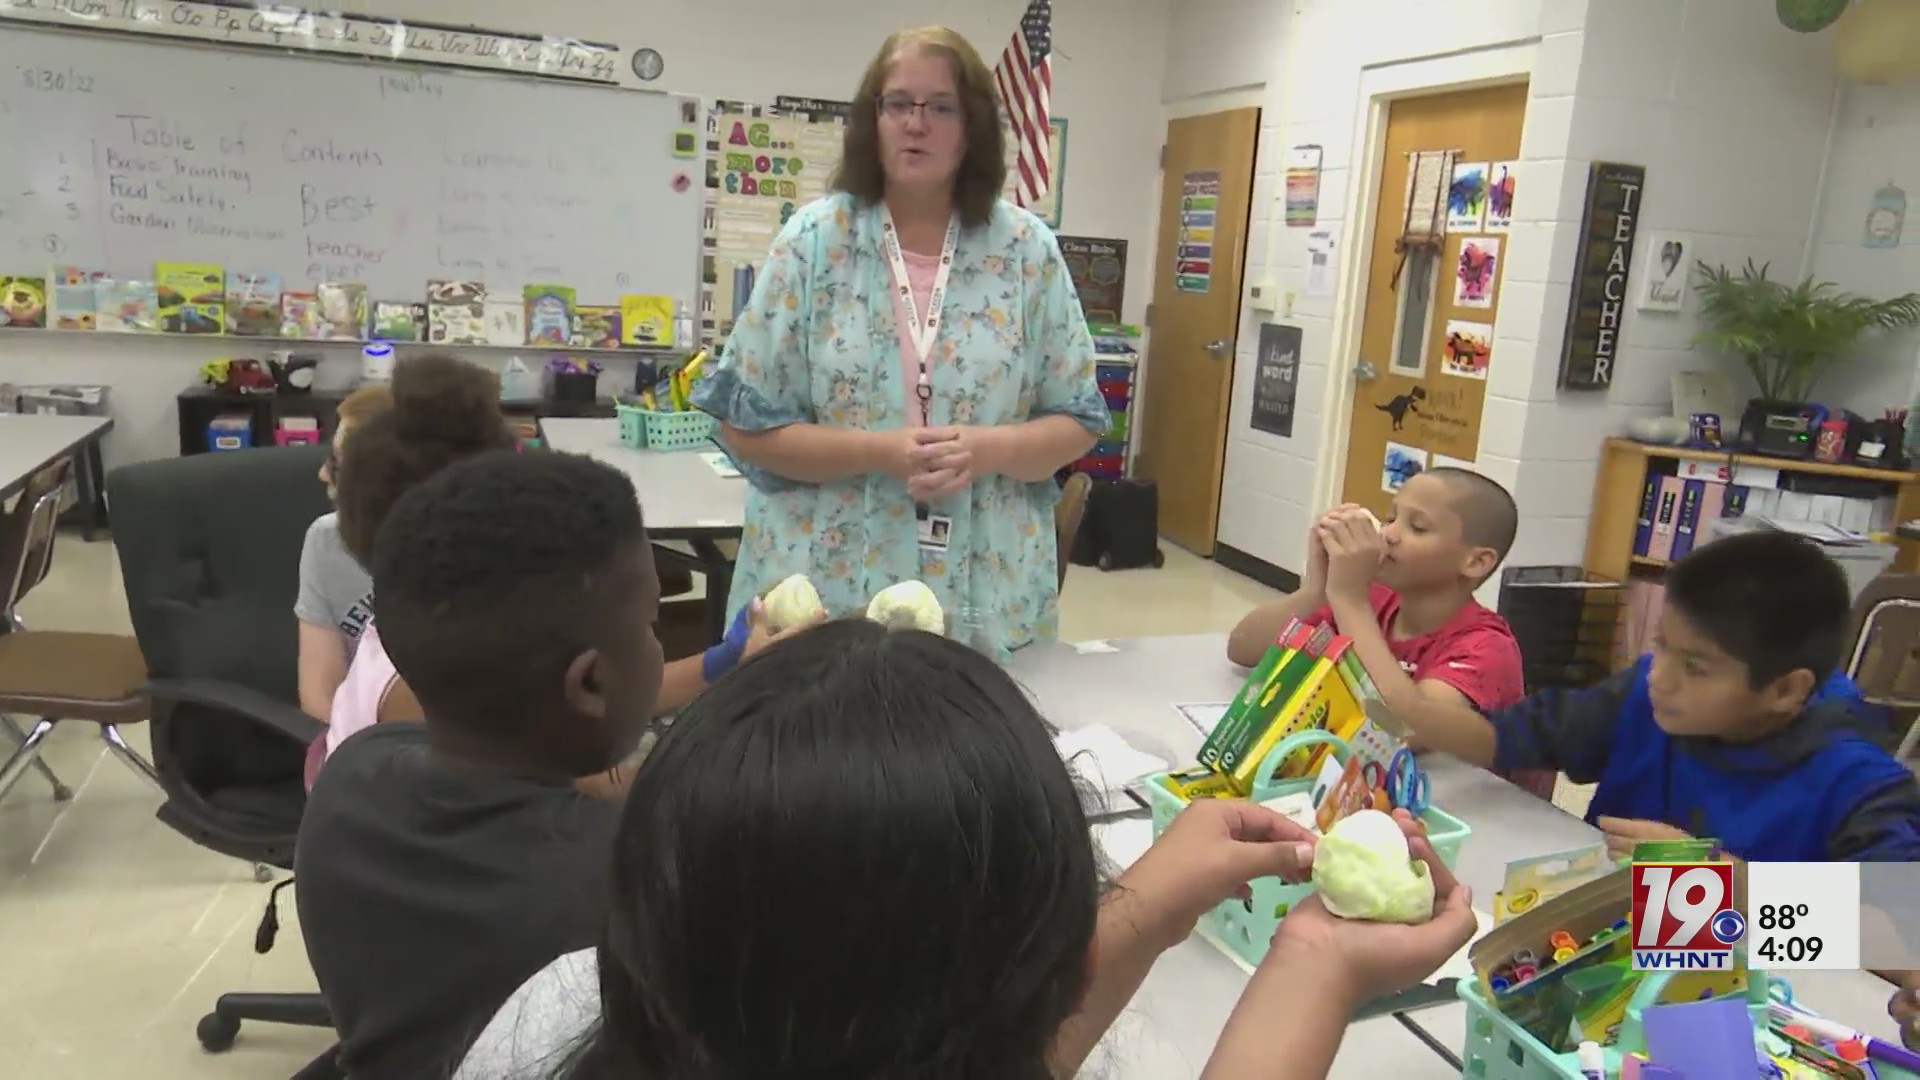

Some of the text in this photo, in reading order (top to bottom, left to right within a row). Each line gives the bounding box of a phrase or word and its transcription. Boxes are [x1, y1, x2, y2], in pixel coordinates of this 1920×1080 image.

[215, 9, 241, 37] Pp
[115, 114, 383, 168] Table of Contents
[726, 152, 804, 176] more
[58, 175, 74, 192] 2
[111, 173, 149, 200] Food
[725, 171, 797, 199] than
[65, 202, 80, 221] 3
[300, 183, 377, 228] Best
[306, 234, 390, 264] teacher
[305, 262, 366, 282] ever
[1592, 184, 1638, 384] TEACHER
[1262, 365, 1293, 382] word
[1202, 748, 1218, 767] 10
[1220, 751, 1236, 769] 10
